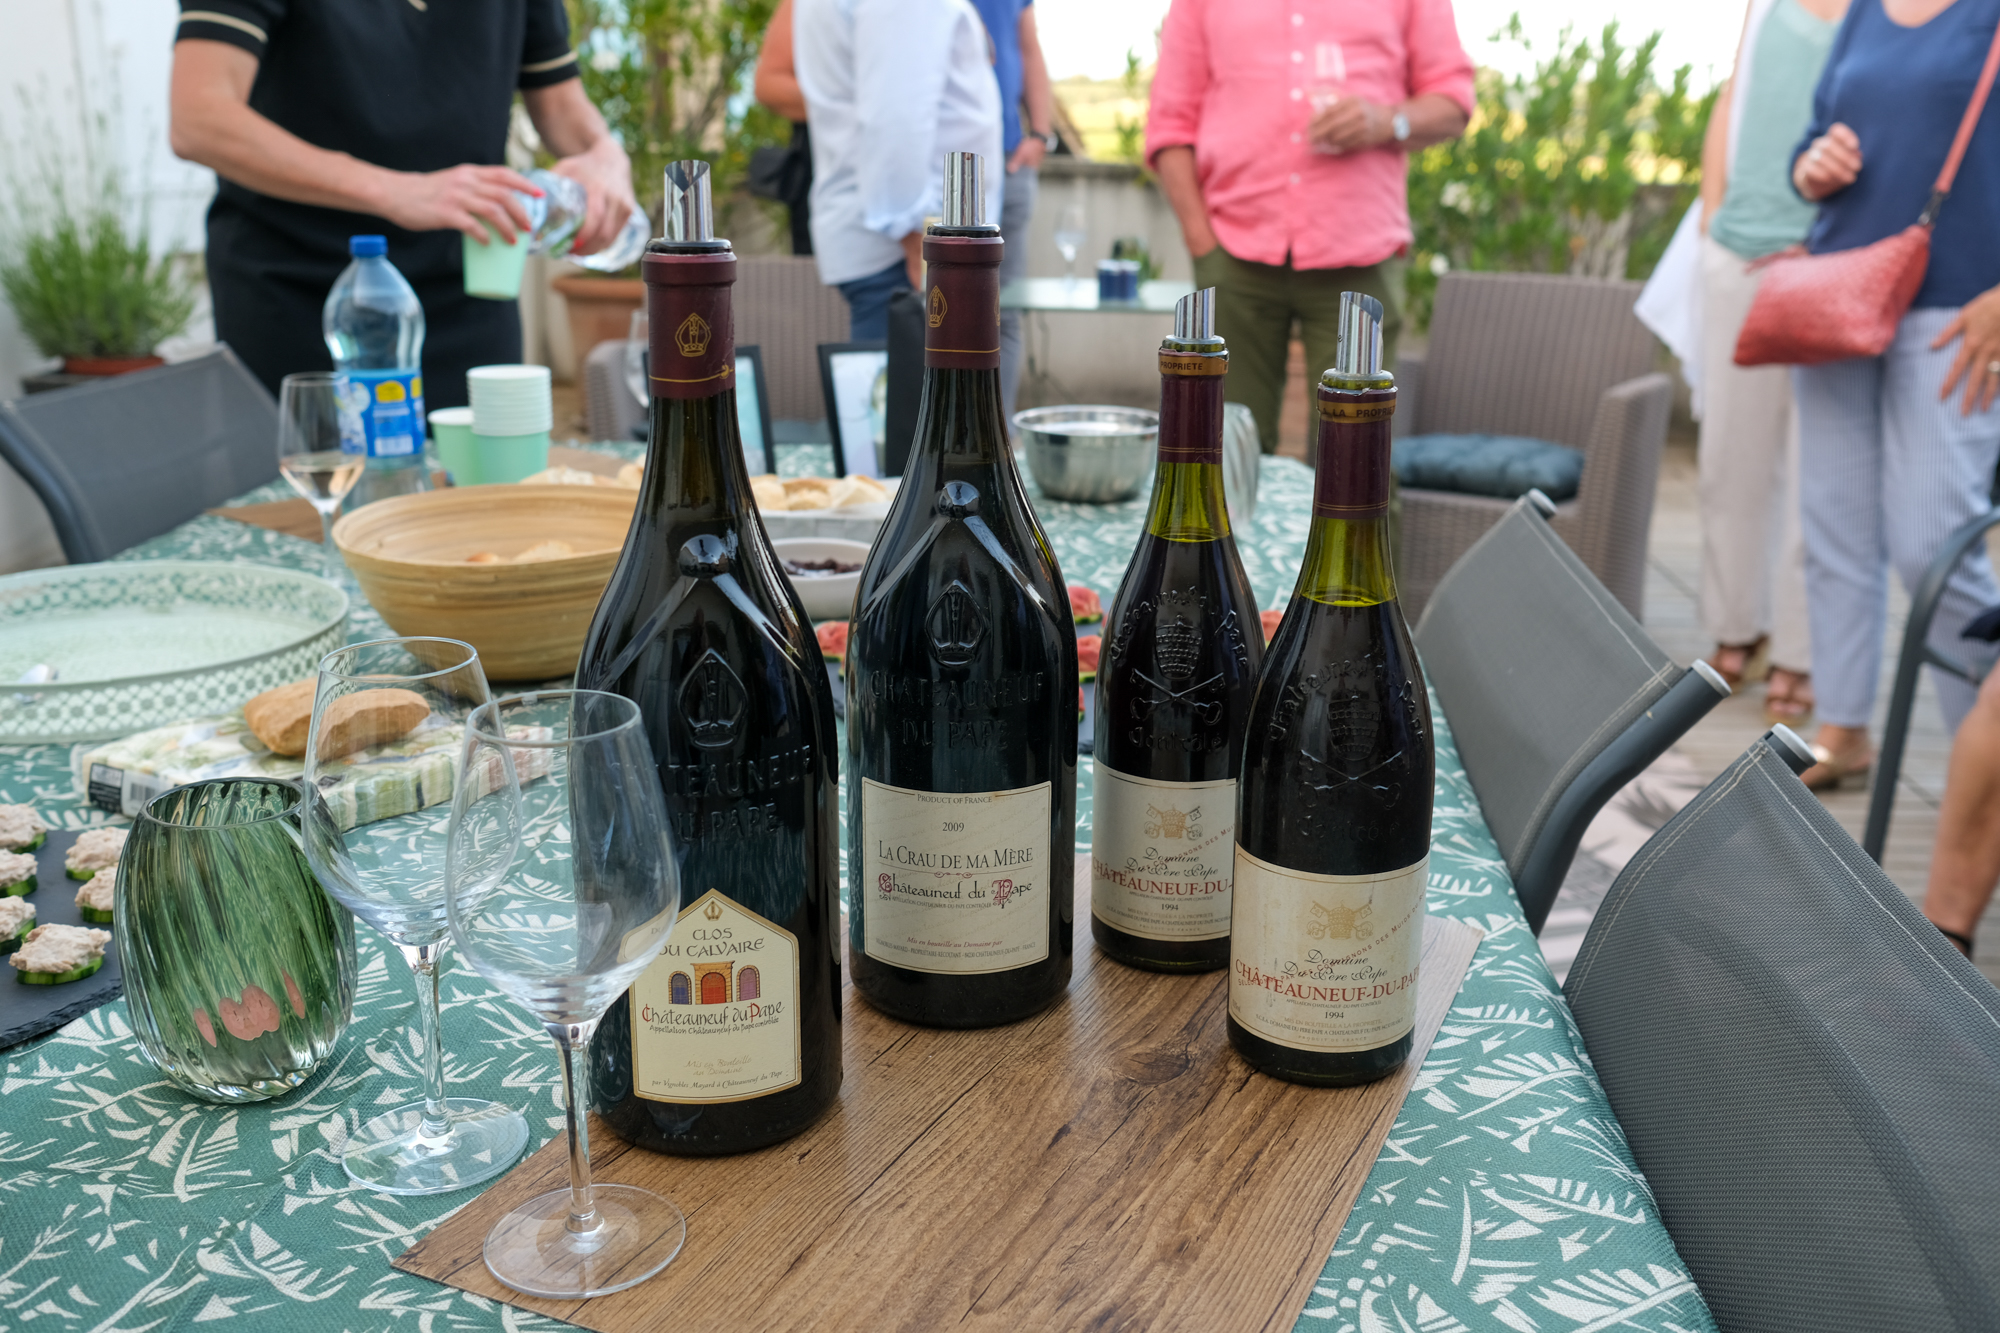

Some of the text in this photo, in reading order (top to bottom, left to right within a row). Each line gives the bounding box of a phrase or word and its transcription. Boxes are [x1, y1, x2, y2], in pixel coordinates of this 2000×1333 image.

[1160, 361, 1203, 371] PROPRIETE
[1332, 408, 1347, 418] LA
[870, 670, 1043, 711] CHATEAUNEUF
[902, 719, 1008, 751] DU PAPE
[709, 802, 777, 842] PAPE
[942, 821, 964, 832] 2009
[879, 840, 1034, 869] LA CRAU DE MA MÈRE
[1142, 846, 1200, 863] Domaine
[1183, 863, 1219, 880] Pape
[878, 872, 1033, 909] Châteauneuf du Pape
[1161, 903, 1179, 911] 1994
[692, 927, 733, 941] CLOS
[906, 936, 918, 945] Mis
[926, 939, 952, 948] bouteille
[963, 940, 991, 948] Domaine
[992, 939, 1004, 948] par
[1375, 933, 1389, 945] DES
[686, 937, 765, 958] CALVAIRE
[1303, 948, 1369, 966] Domaine
[1351, 964, 1388, 984] Pape
[732, 1007, 749, 1023] du
[749, 1001, 785, 1023] Pape
[1325, 1011, 1344, 1019] 1994
[649, 1024, 687, 1035] Appellation
[732, 1024, 741, 1032] du
[741, 1023, 755, 1034] Pape
[1269, 1019, 1291, 1031] DOMAINE
[1328, 1028, 1364, 1036] CHATEAUNEUF
[1284, 1016, 1295, 1024] MIS
[1304, 1020, 1336, 1029] BOUTEILLE
[683, 1060, 702, 1069] Mis
[703, 1061, 714, 1069] en
[707, 1067, 744, 1076] Domaine
[651, 1080, 662, 1088] par
[662, 1078, 690, 1089] Vignobles
[690, 1081, 716, 1091] Mayard
[760, 1073, 770, 1082] du
[769, 1070, 783, 1079] Pape
